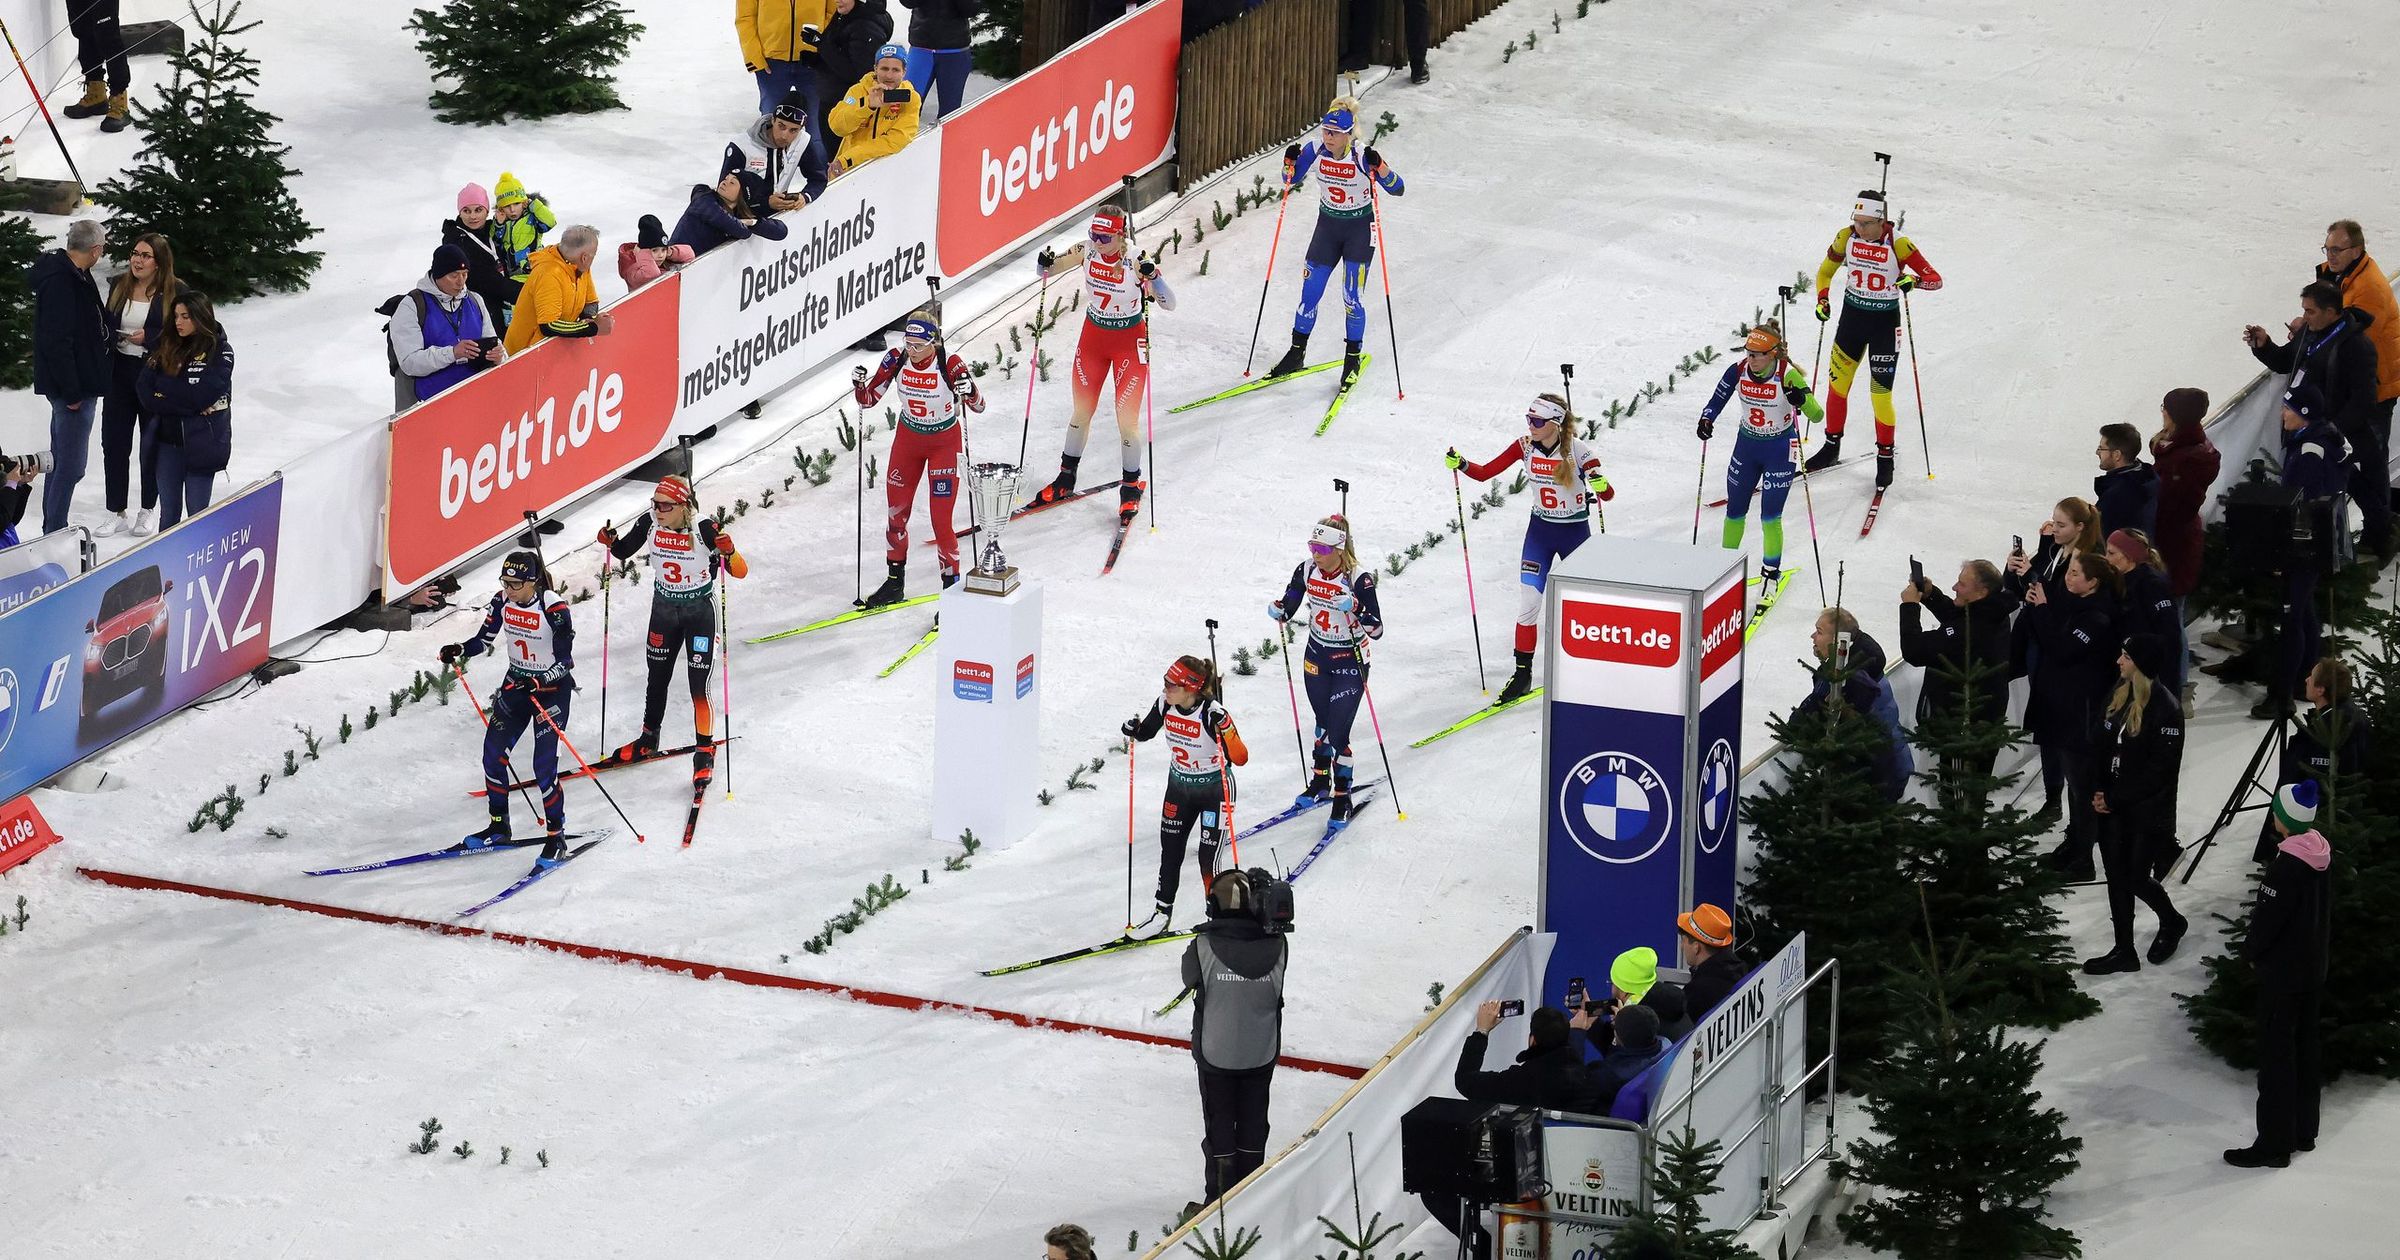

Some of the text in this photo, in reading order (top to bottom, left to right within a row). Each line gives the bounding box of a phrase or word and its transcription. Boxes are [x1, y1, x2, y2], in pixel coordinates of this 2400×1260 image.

[980, 79, 1135, 217] bett1.de
[1321, 164, 1354, 175] bett1.de
[1328, 186, 1346, 204] 9
[740, 199, 875, 312] Deutschlands
[1853, 246, 1886, 259] bett1.de
[1851, 270, 1886, 291] 10
[1094, 291, 1112, 310] 7
[683, 241, 925, 408] meistgekaufte Matratze
[903, 373, 936, 385] bett1.de
[1741, 384, 1774, 396] bett1.de
[908, 399, 928, 417] 5
[1749, 408, 1765, 427] 8
[439, 368, 624, 519] bett1.de
[1540, 487, 1557, 509] 6
[187, 524, 252, 569] THE NEW
[663, 562, 682, 583] 3
[180, 547, 266, 675] iX2
[505, 611, 538, 626] bett1.de
[1315, 610, 1331, 632] 4
[1570, 619, 1672, 649] bett1.de
[1701, 608, 1742, 660] bett1.de
[514, 640, 529, 660] 1
[956, 666, 991, 679] bett1.de
[1166, 719, 1199, 734] bett1.de
[1172, 746, 1191, 768] 2
[1577, 757, 1659, 792] BMW
[459, 846, 494, 857] SALOMON
[1707, 977, 1765, 1064] VELTINS
[1555, 1191, 1633, 1217] VELTINS
[1505, 1248, 1537, 1259] VELTINS
